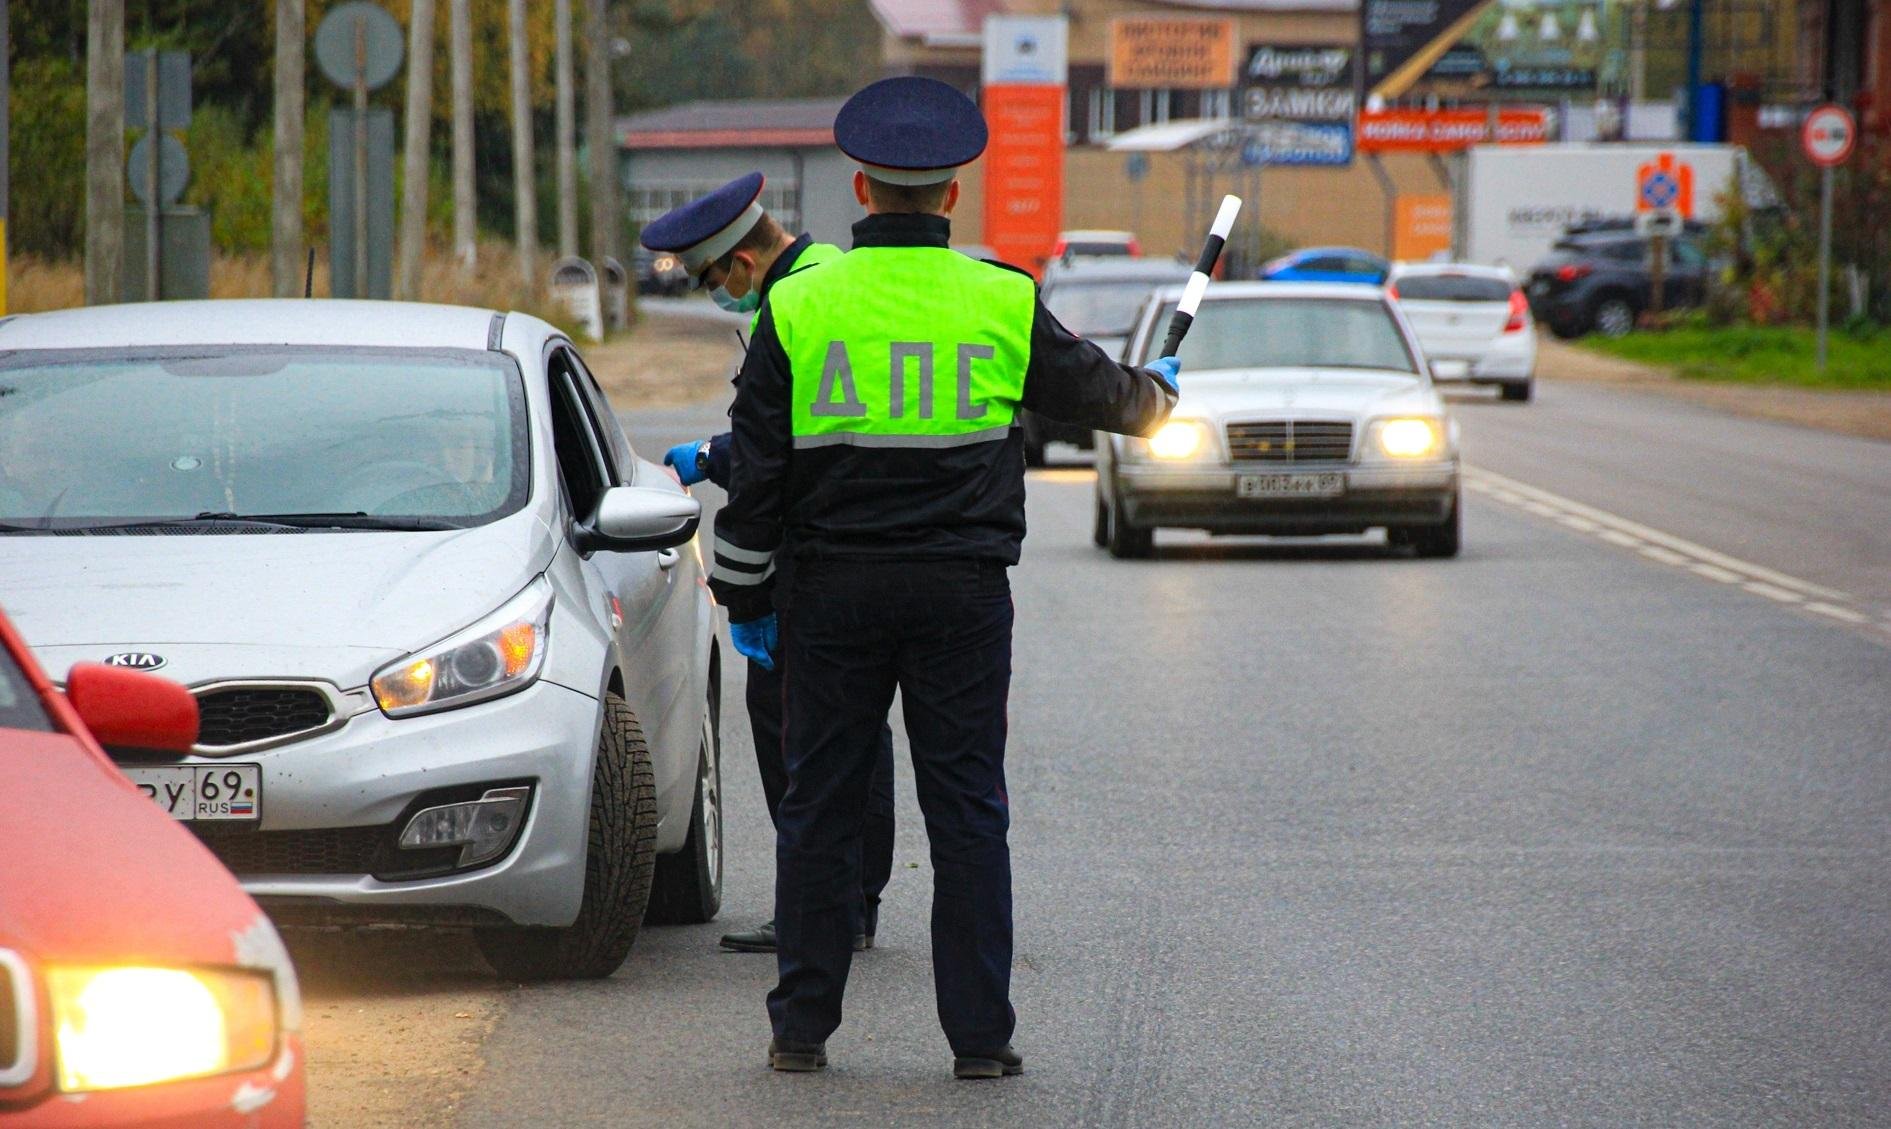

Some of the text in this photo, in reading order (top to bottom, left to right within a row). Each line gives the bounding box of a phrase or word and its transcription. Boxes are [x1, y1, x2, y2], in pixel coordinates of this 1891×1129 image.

[810, 340, 995, 421] ДПС
[112, 653, 156, 666] KIA
[201, 771, 242, 800] 69
[199, 802, 229, 814] RUS
